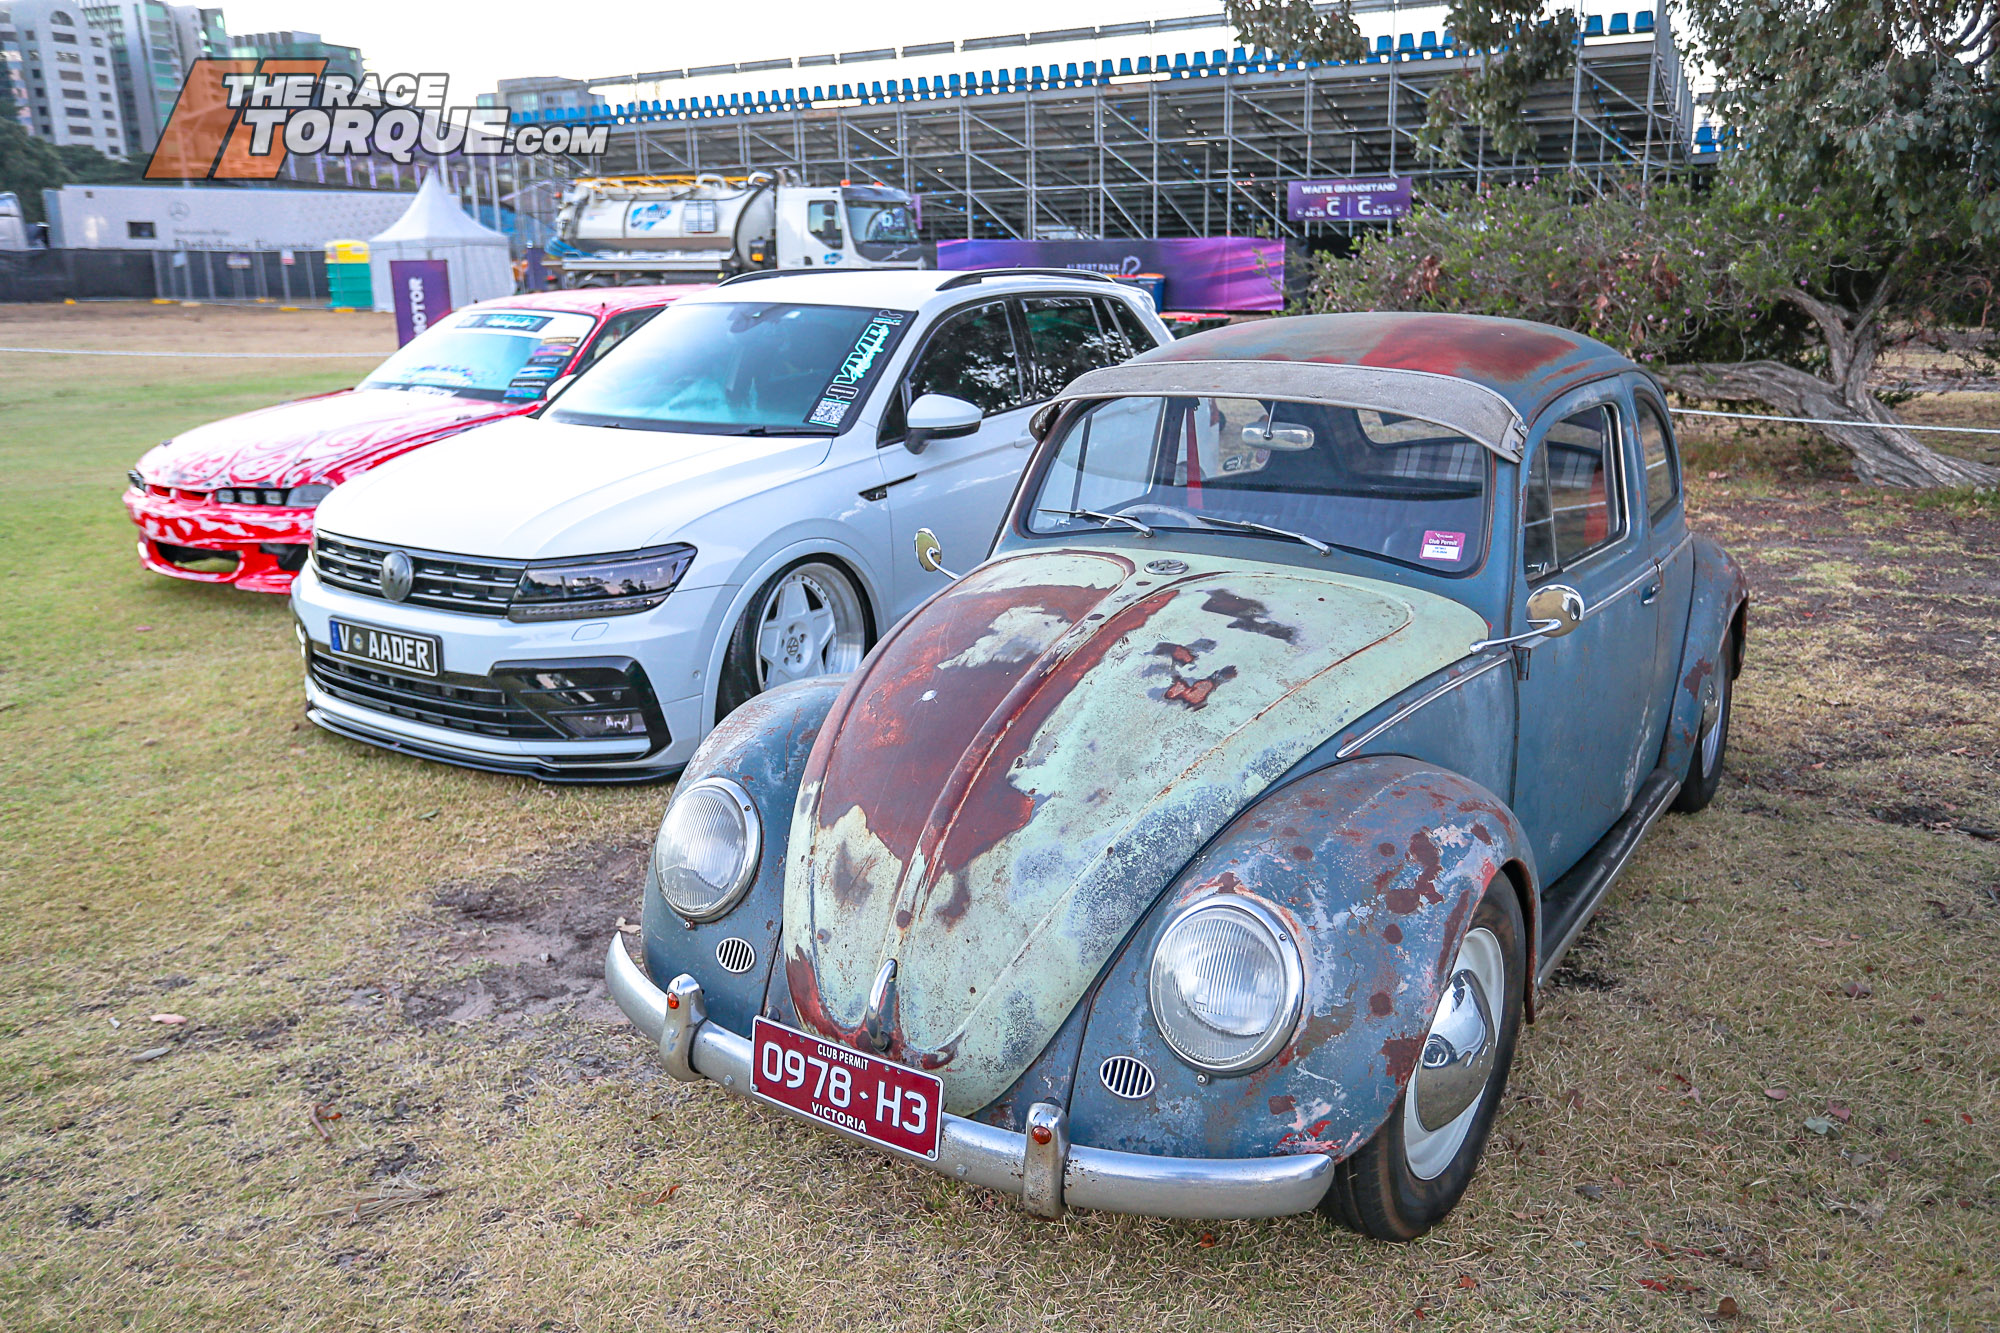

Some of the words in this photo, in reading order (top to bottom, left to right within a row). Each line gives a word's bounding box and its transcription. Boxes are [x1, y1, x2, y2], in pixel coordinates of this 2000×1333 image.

[1301, 185, 1333, 194] WAITE
[1334, 183, 1397, 192] GRANDSTAND
[1326, 201, 1340, 216] C
[1358, 200, 1371, 215] C
[1098, 263, 1119, 271] PARK
[338, 624, 350, 652] V
[368, 630, 430, 671] AADER
[817, 1043, 838, 1060] CLUB
[839, 1052, 869, 1071] PERMIT
[811, 1101, 867, 1133] VICTORIA
